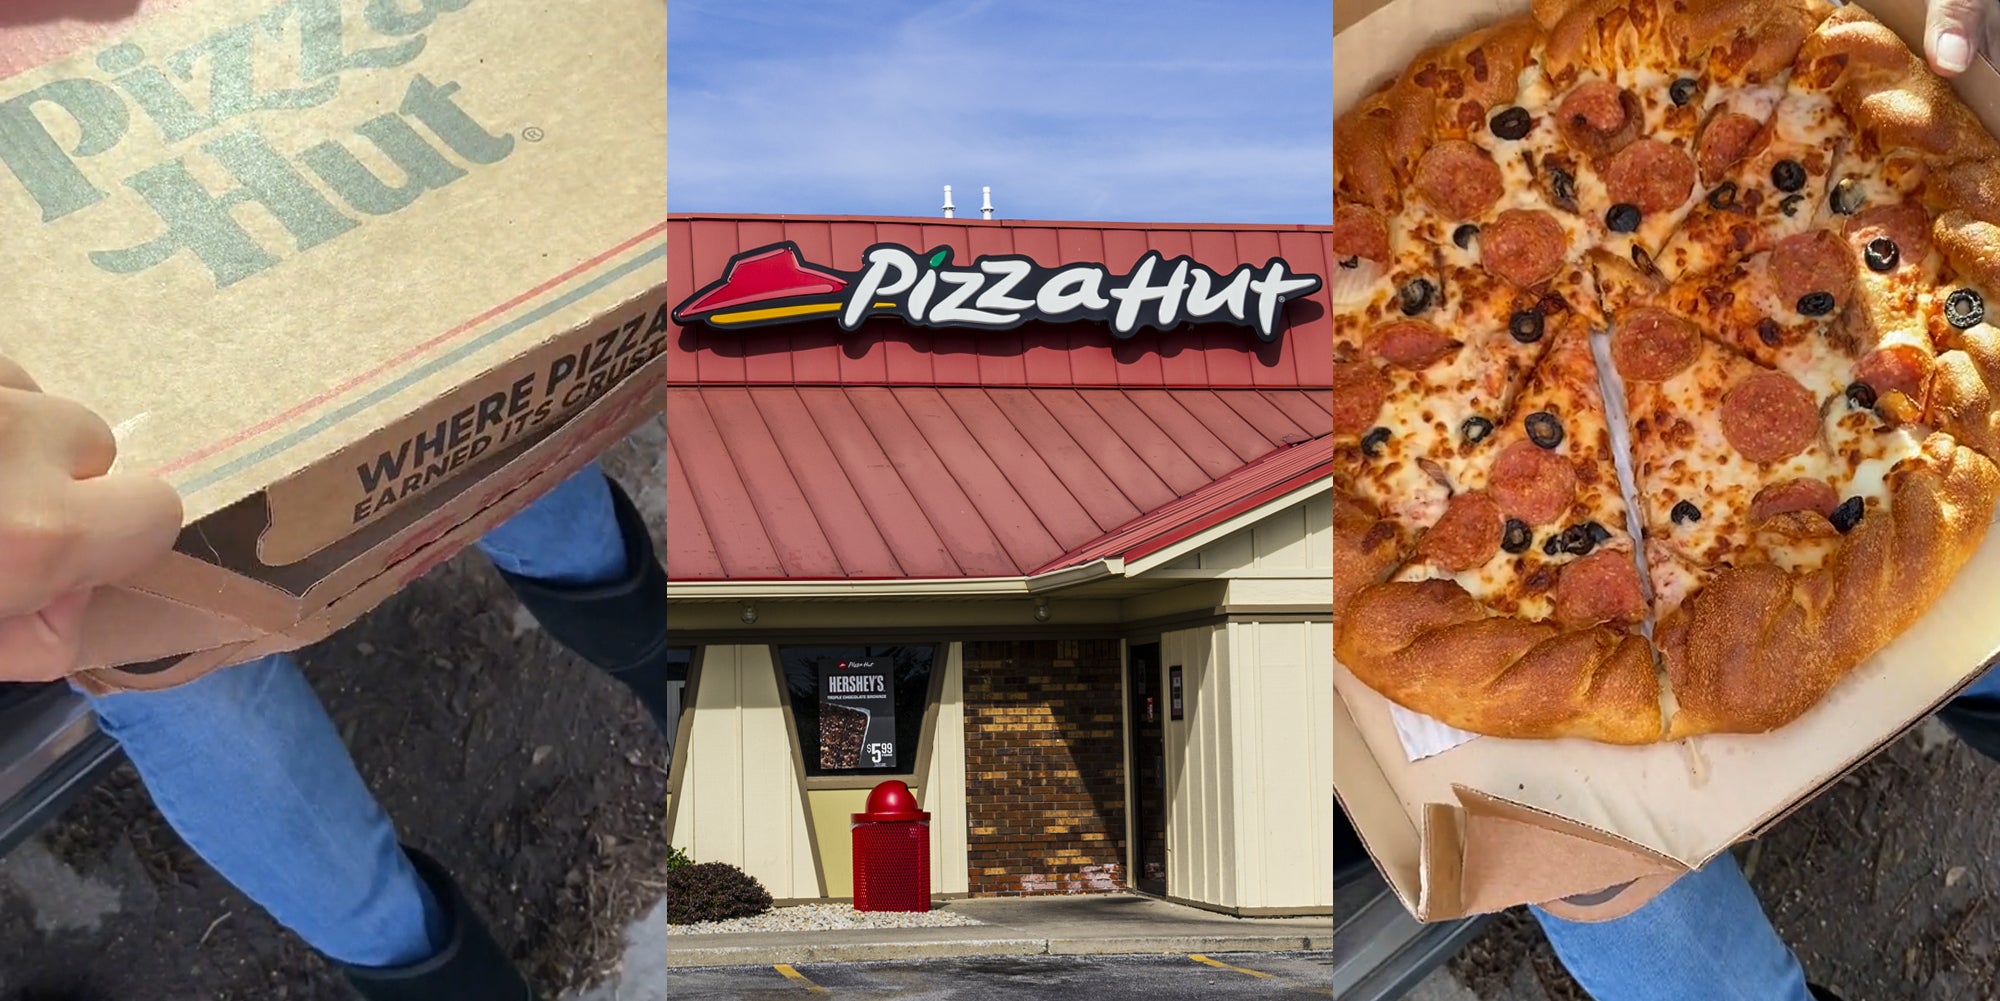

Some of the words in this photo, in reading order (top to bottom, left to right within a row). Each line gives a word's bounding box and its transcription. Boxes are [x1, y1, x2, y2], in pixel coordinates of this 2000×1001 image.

[88, 73, 515, 289] Hut
[845, 248, 1109, 327] Pizza
[1110, 252, 1316, 335] Hut
[356, 373, 535, 494] WHERE
[545, 302, 667, 397] PIZZA
[353, 435, 491, 524] EARNED
[500, 400, 553, 442] ITS
[828, 675, 885, 693] HERSHEY'S
